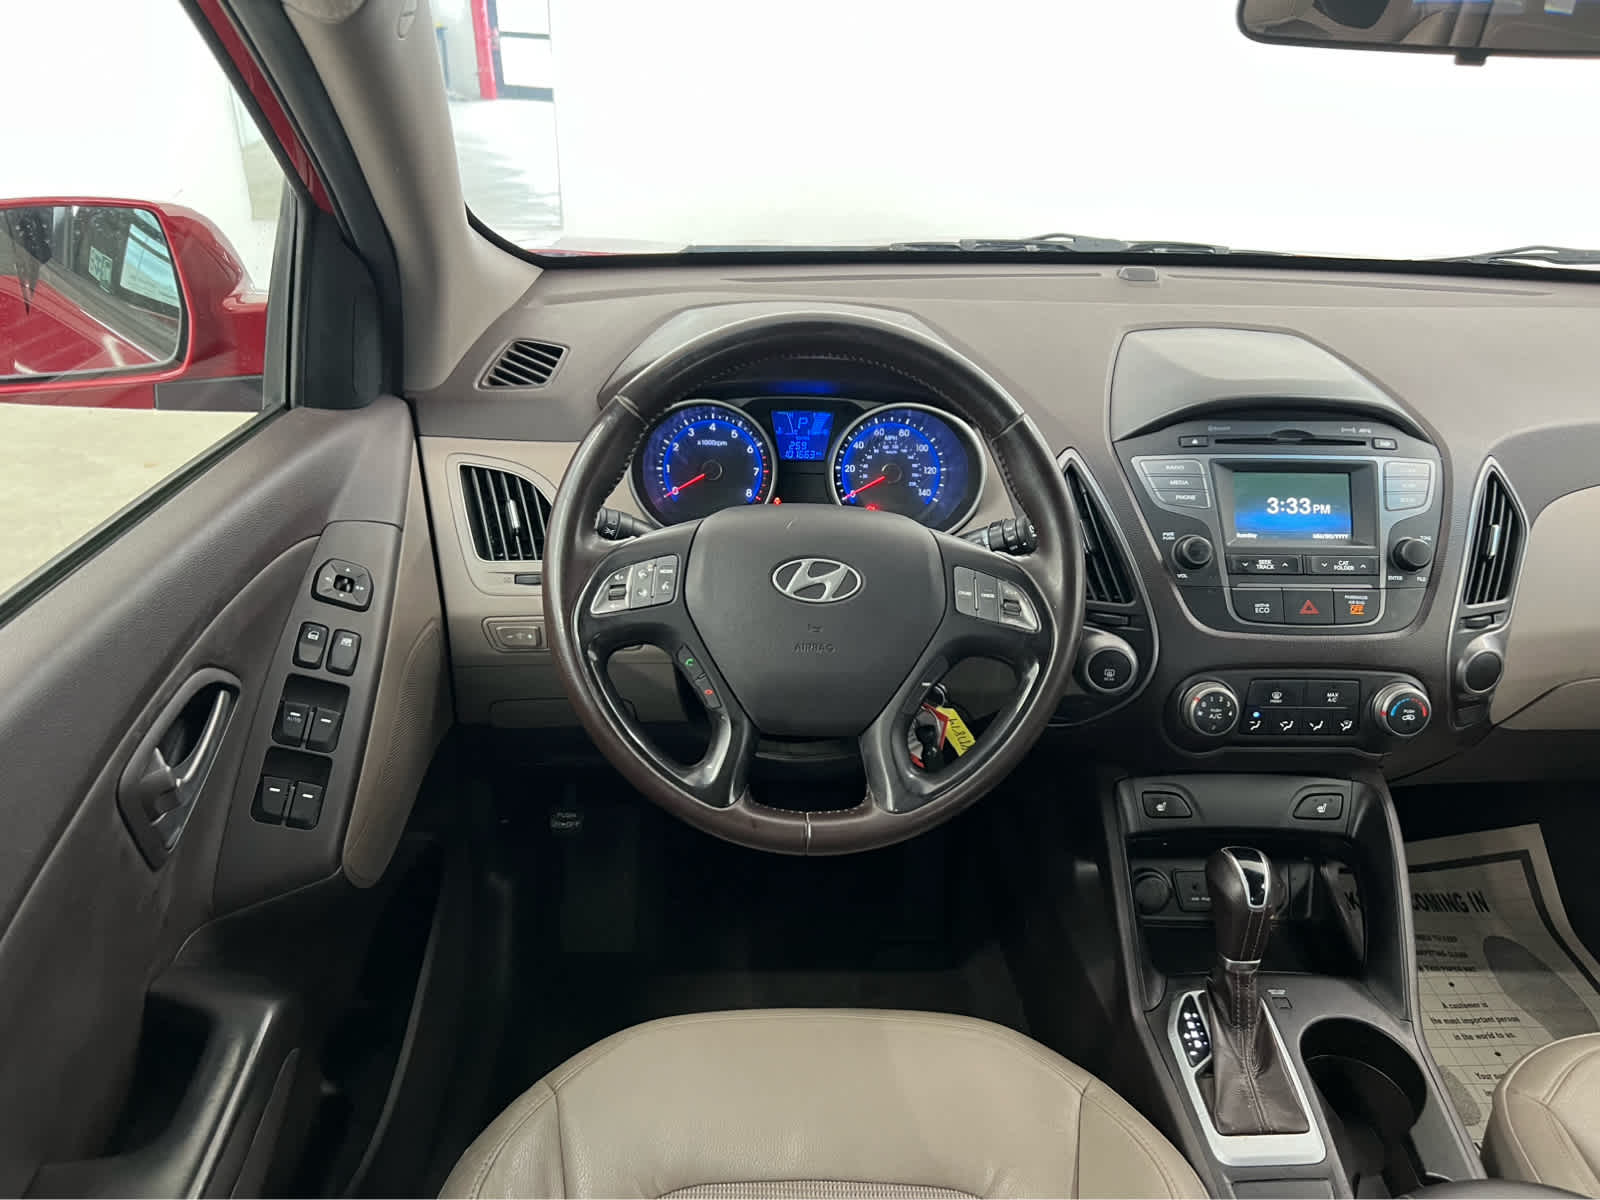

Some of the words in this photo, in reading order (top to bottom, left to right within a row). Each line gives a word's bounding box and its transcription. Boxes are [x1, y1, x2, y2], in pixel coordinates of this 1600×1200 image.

[709, 422, 716, 431] 4
[798, 416, 808, 429] P
[687, 428, 695, 437] 3
[731, 429, 738, 439] 5
[873, 428, 885, 436] 60
[898, 429, 910, 437] 80
[673, 442, 680, 452] 2
[747, 443, 754, 453] 6
[853, 441, 864, 449] 40
[916, 444, 929, 452] 100
[665, 464, 671, 473] 1
[753, 466, 760, 477] 7
[844, 464, 856, 473] 20
[923, 466, 937, 475] 120
[671, 485, 679, 496] 0
[746, 488, 753, 498] 8
[850, 490, 856, 499] 0
[918, 488, 932, 497] 140
[1266, 497, 1312, 515] 3:33
[1312, 504, 1331, 515] PM
[1466, 891, 1491, 913] IN
